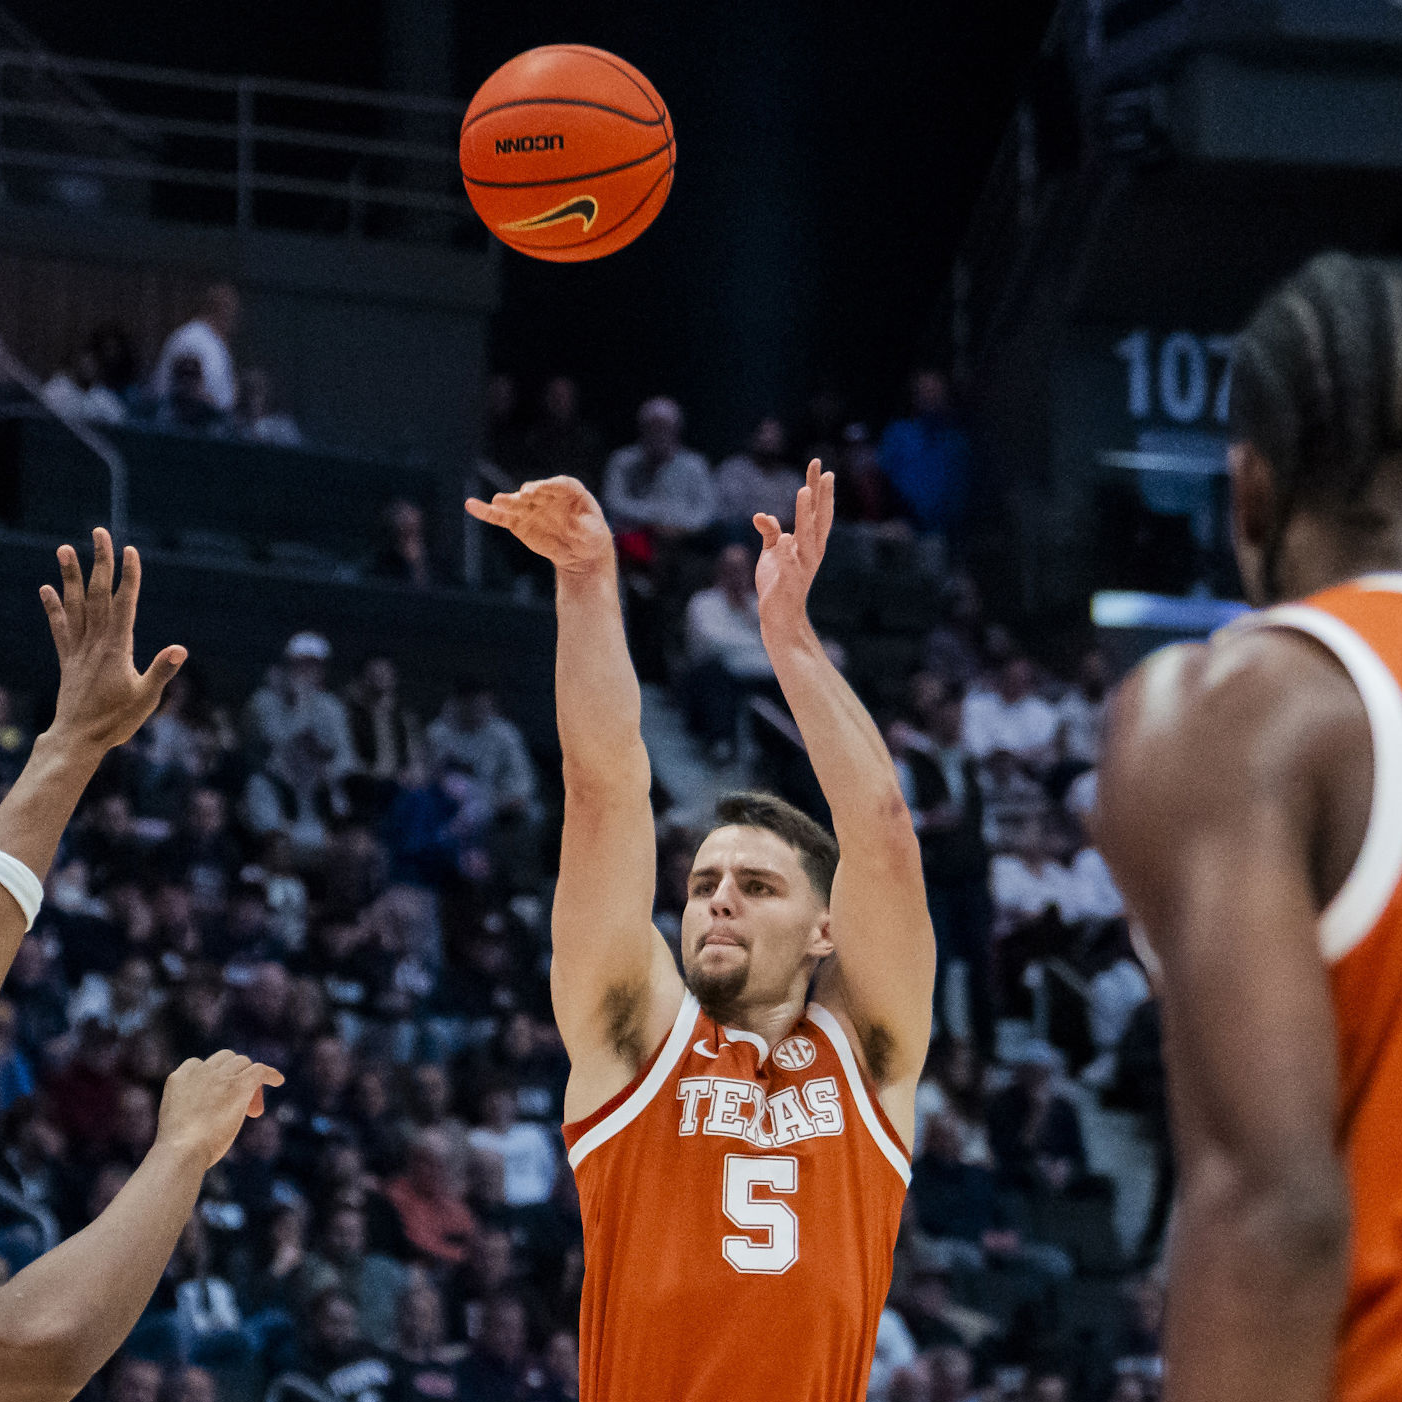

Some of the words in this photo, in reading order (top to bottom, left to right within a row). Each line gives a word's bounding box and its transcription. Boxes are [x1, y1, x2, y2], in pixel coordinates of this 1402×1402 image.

[495, 134, 565, 155] UCONN
[775, 1037, 816, 1070] SEC
[676, 1076, 845, 1148] TEXAS
[722, 1153, 799, 1275] 5
